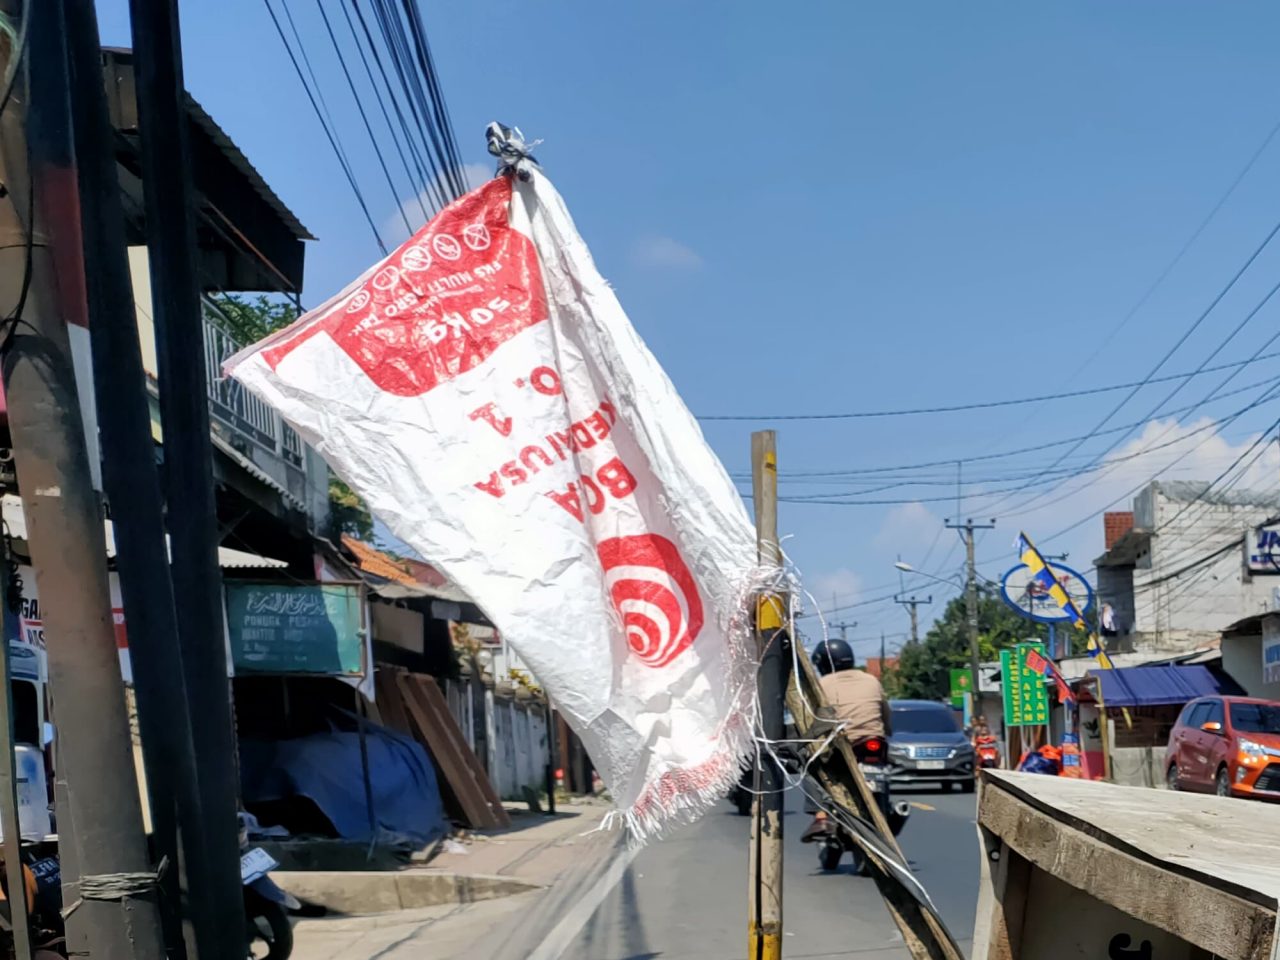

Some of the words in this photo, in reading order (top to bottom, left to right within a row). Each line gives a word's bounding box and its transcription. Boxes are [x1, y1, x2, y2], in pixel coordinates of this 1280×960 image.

[427, 272, 473, 296] MULTI
[470, 298, 511, 324] 50
[467, 401, 513, 437] 1
[474, 445, 554, 498] USA
